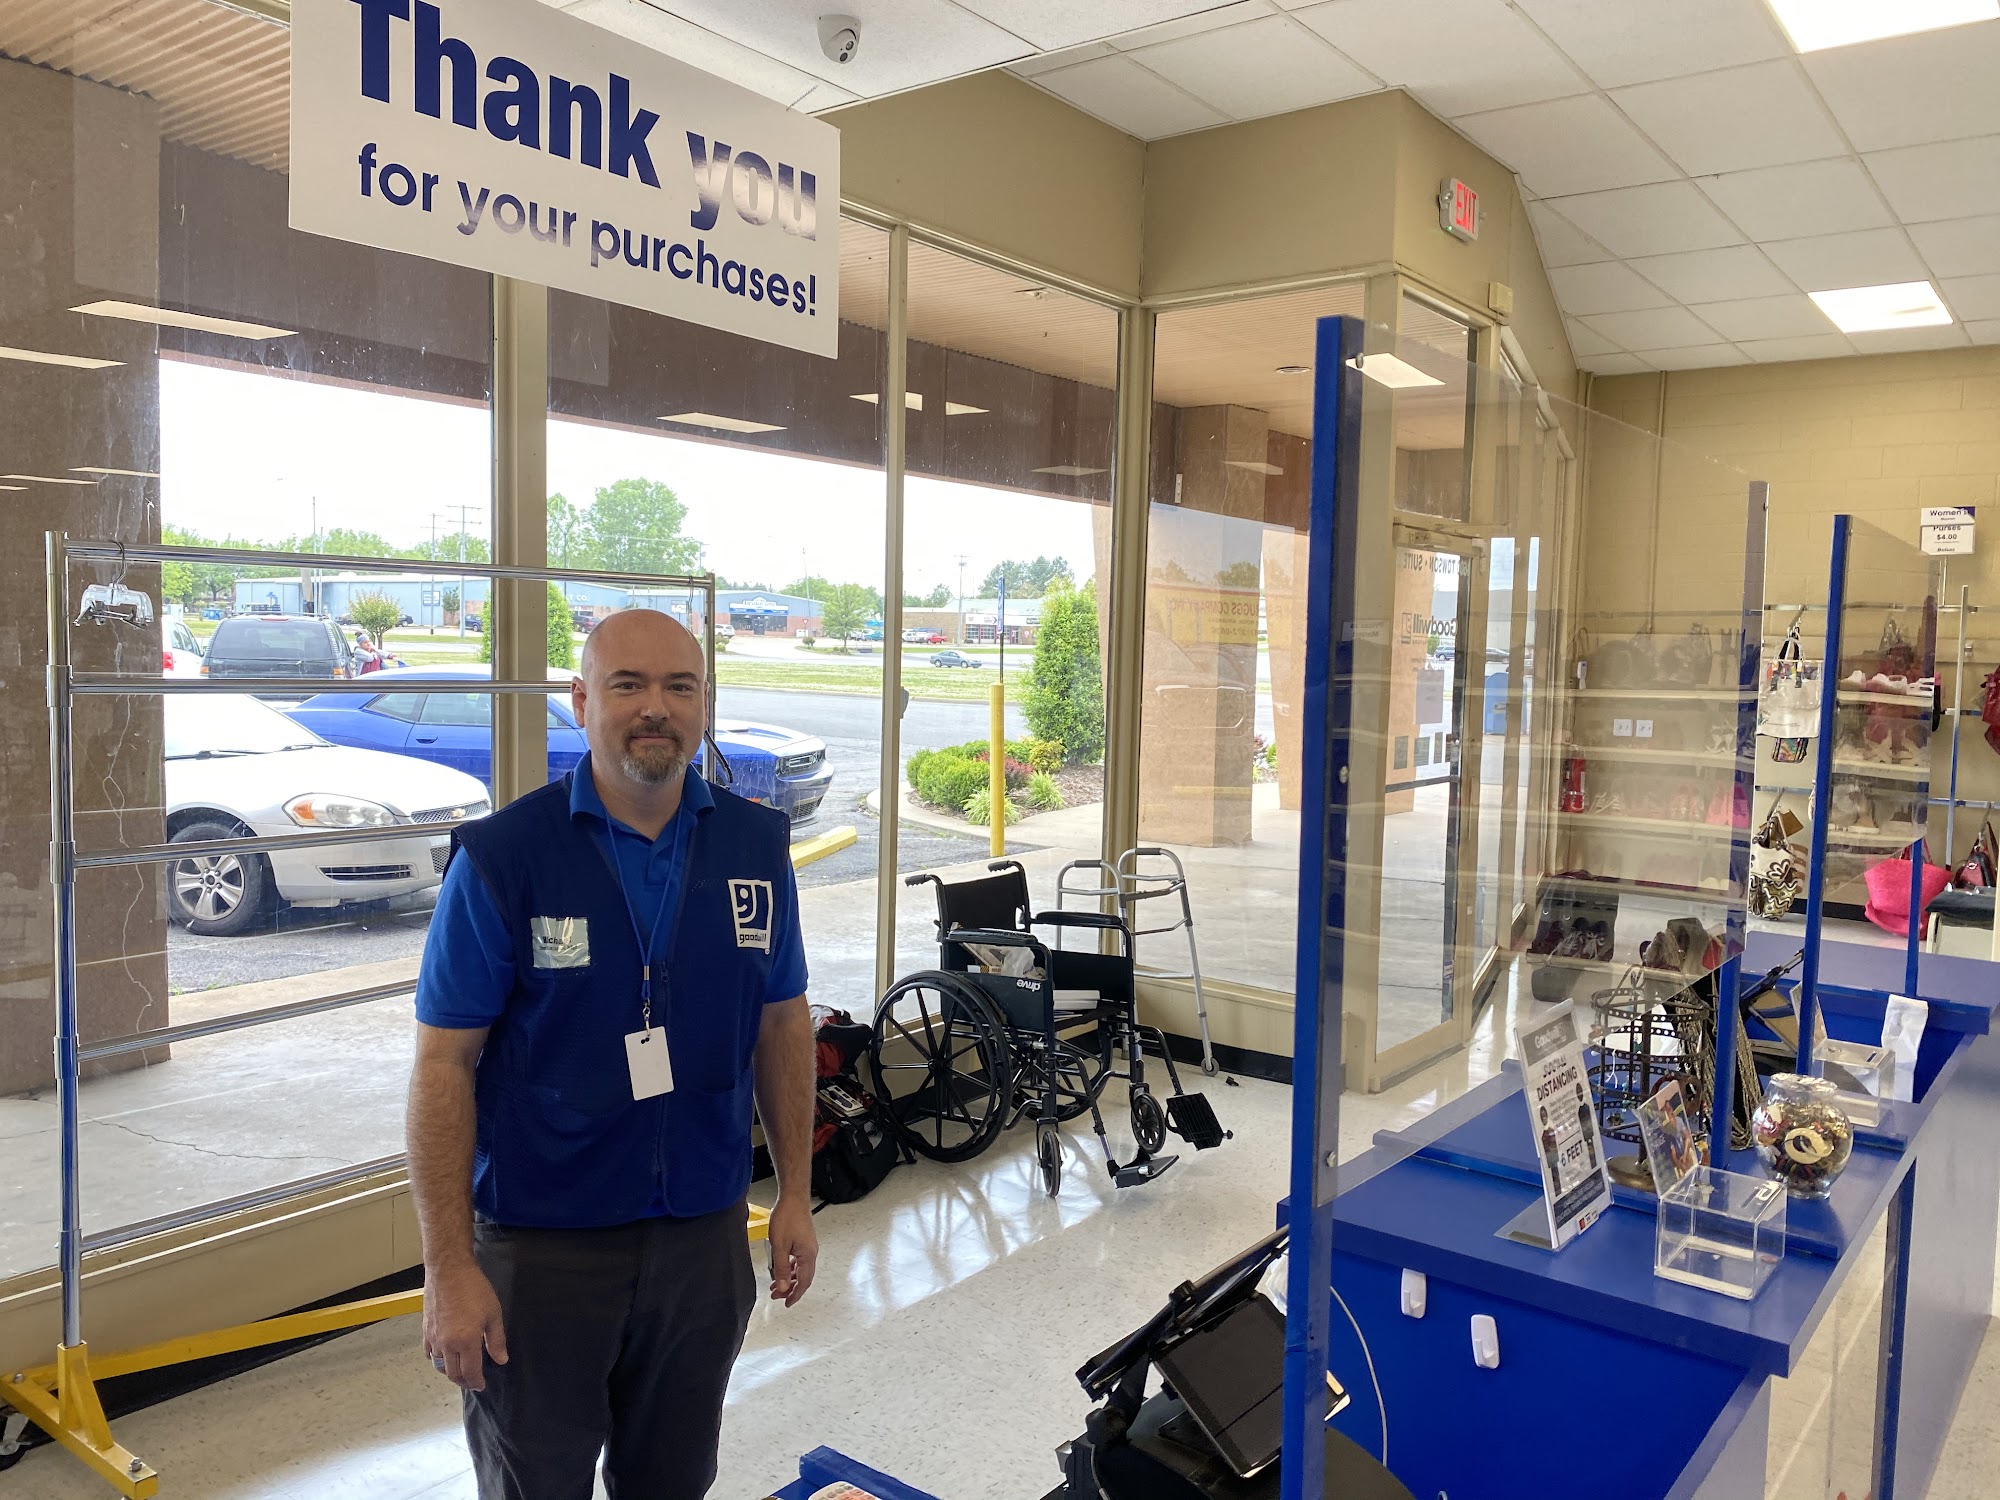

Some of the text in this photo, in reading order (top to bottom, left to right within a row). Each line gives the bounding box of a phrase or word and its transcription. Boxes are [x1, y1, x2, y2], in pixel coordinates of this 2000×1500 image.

[351, 0, 816, 242] Thank you
[1456, 182, 1477, 234] EXIT
[358, 143, 816, 317] for your purchases!
[1936, 533, 1957, 541] $4.00
[739, 933, 767, 945] goodwill
[1016, 978, 1041, 993] drive
[1536, 1065, 1578, 1102] DISTANCING
[1566, 1140, 1583, 1163] FEET
